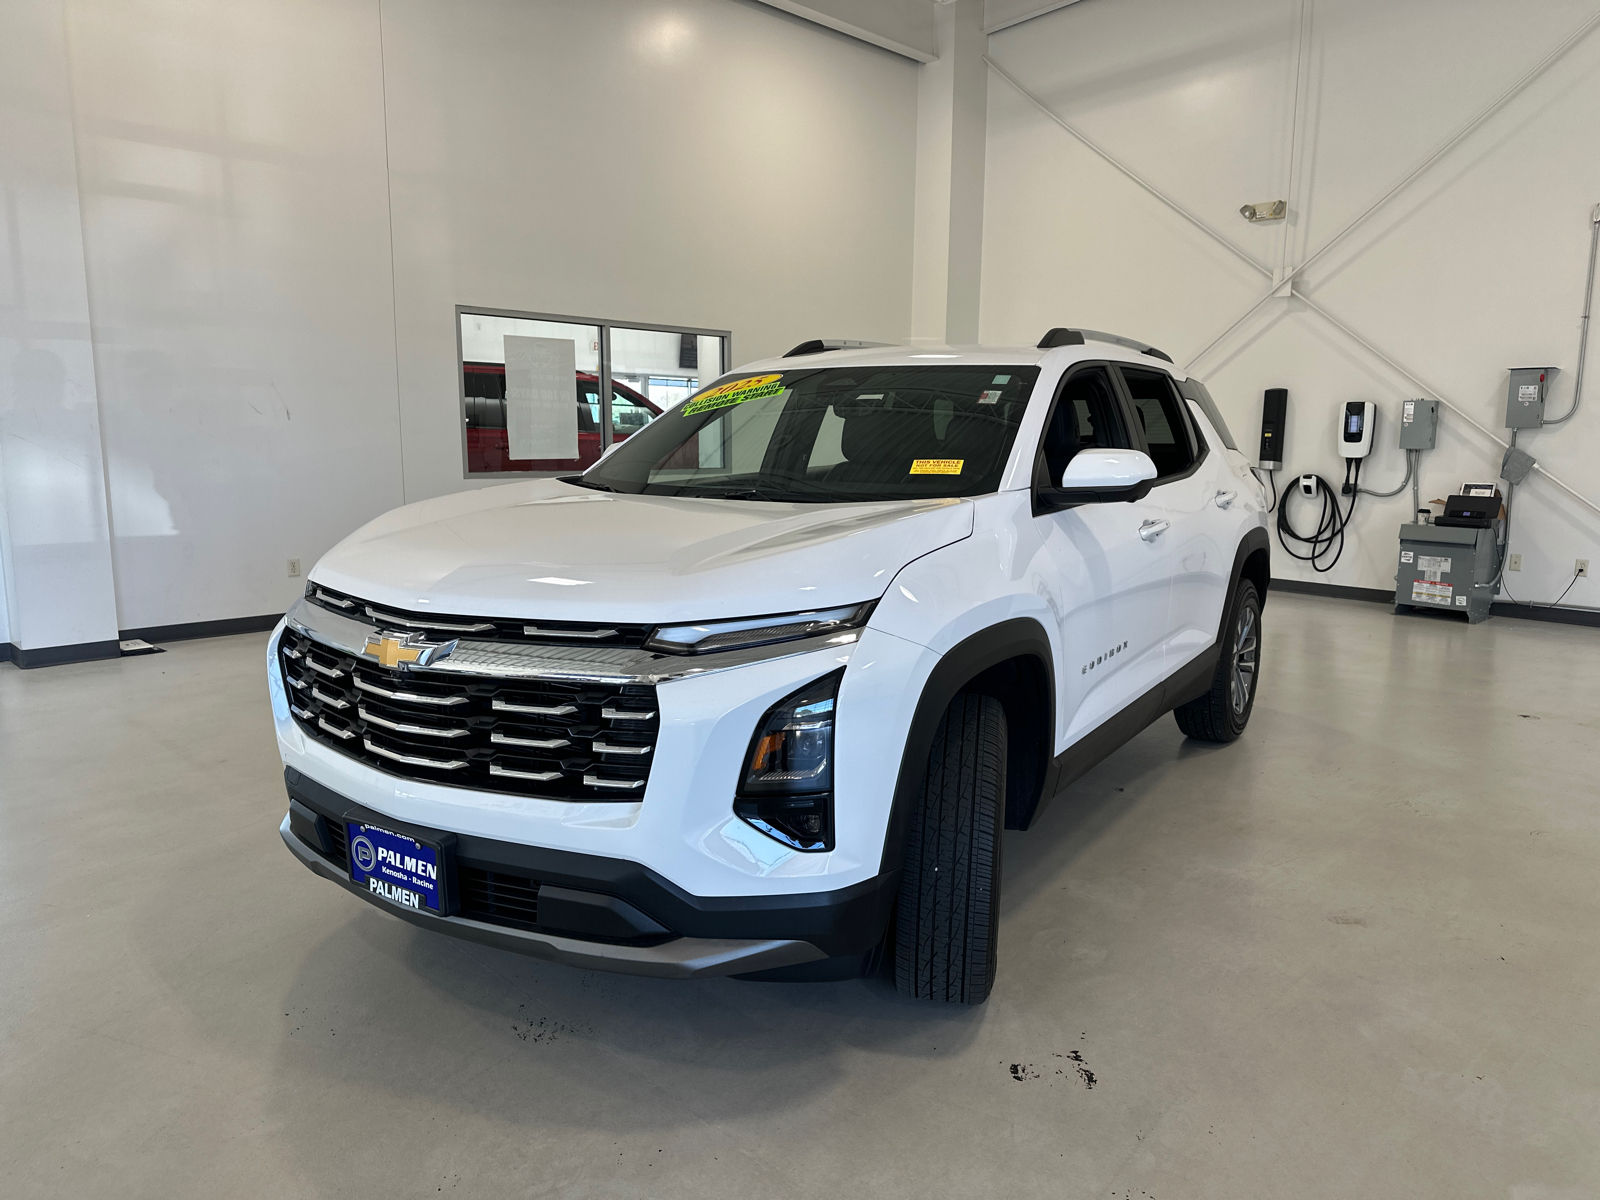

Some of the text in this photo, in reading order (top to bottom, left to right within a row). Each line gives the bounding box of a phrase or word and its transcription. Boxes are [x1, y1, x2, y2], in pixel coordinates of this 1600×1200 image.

[683, 384, 778, 410] COLLISION WARNING
[704, 375, 769, 399] 2025
[687, 387, 781, 414] REMOTE START
[1082, 640, 1128, 675] EQUINOX
[364, 824, 416, 843] palmen.com
[377, 846, 437, 880] PALMEN
[381, 865, 408, 881] Kenosha
[412, 876, 434, 890] Racine
[369, 877, 419, 909] PALMEN
